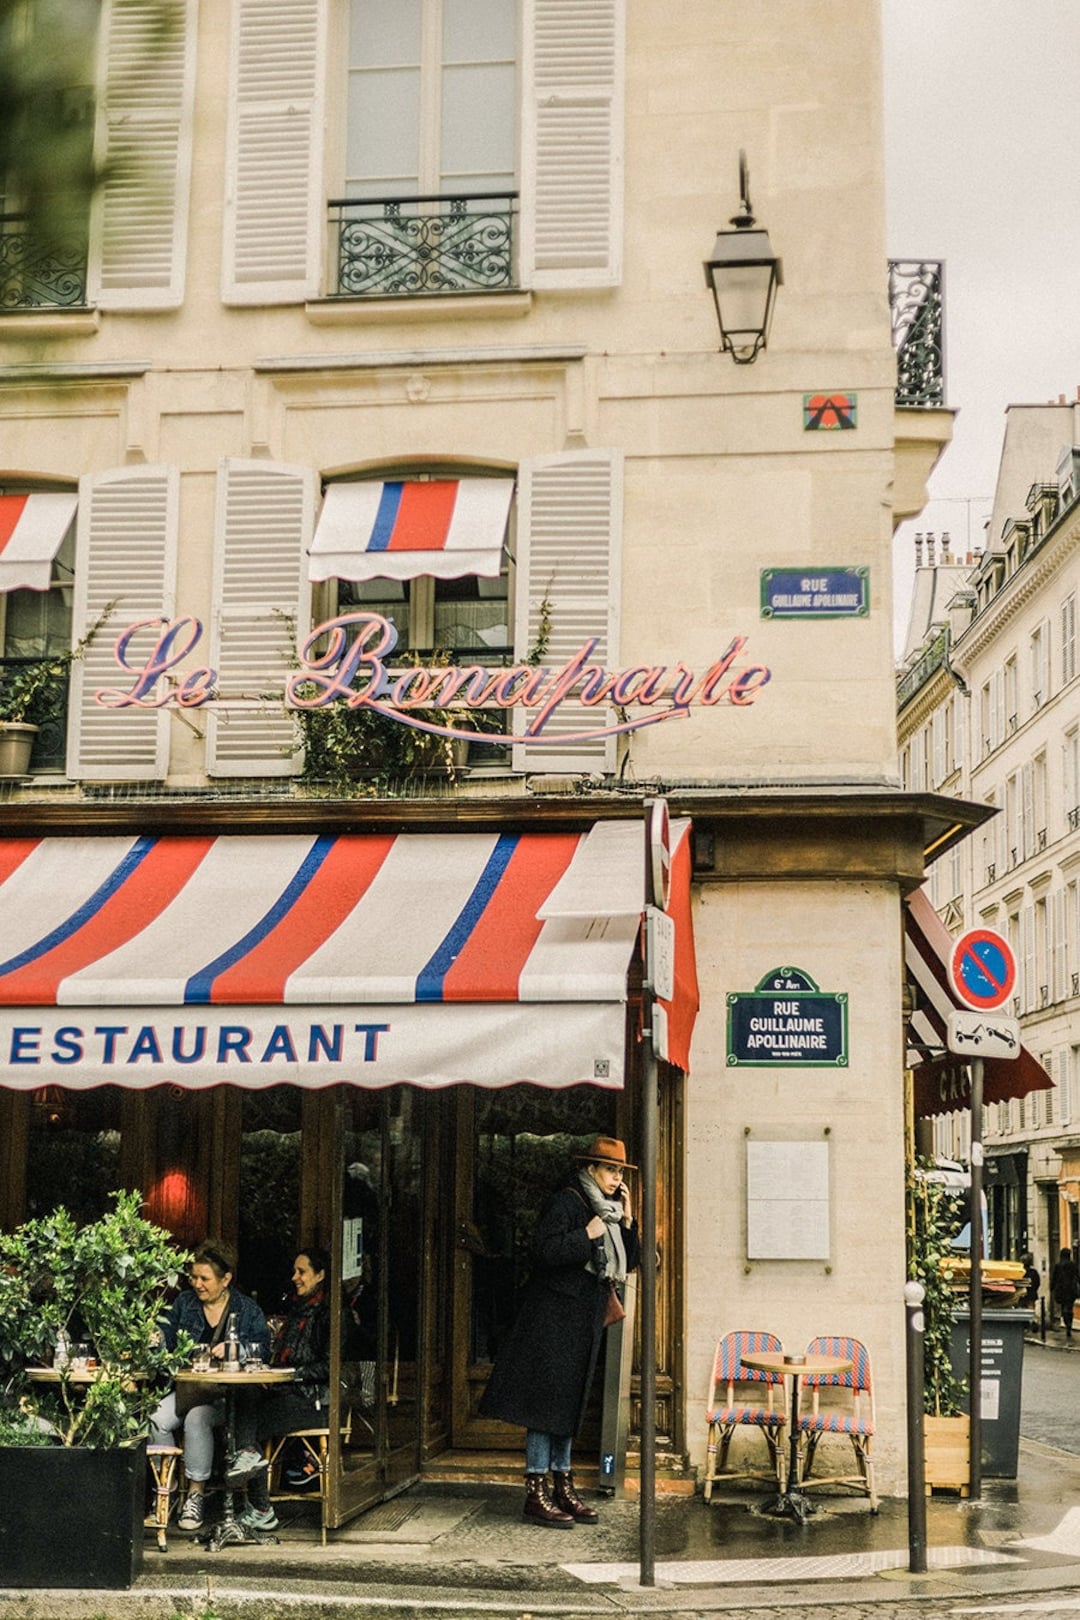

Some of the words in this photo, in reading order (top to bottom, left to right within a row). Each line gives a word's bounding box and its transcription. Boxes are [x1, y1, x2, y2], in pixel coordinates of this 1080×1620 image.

[801, 579, 828, 592] RUE
[95, 615, 217, 708] Le
[288, 612, 771, 743] Bonaparte
[774, 1001, 800, 1015] RUE
[750, 1018, 824, 1032] GUILLAUME
[9, 1023, 391, 1064] ESTAURANT
[747, 1034, 827, 1049] APOLLINAIRE
